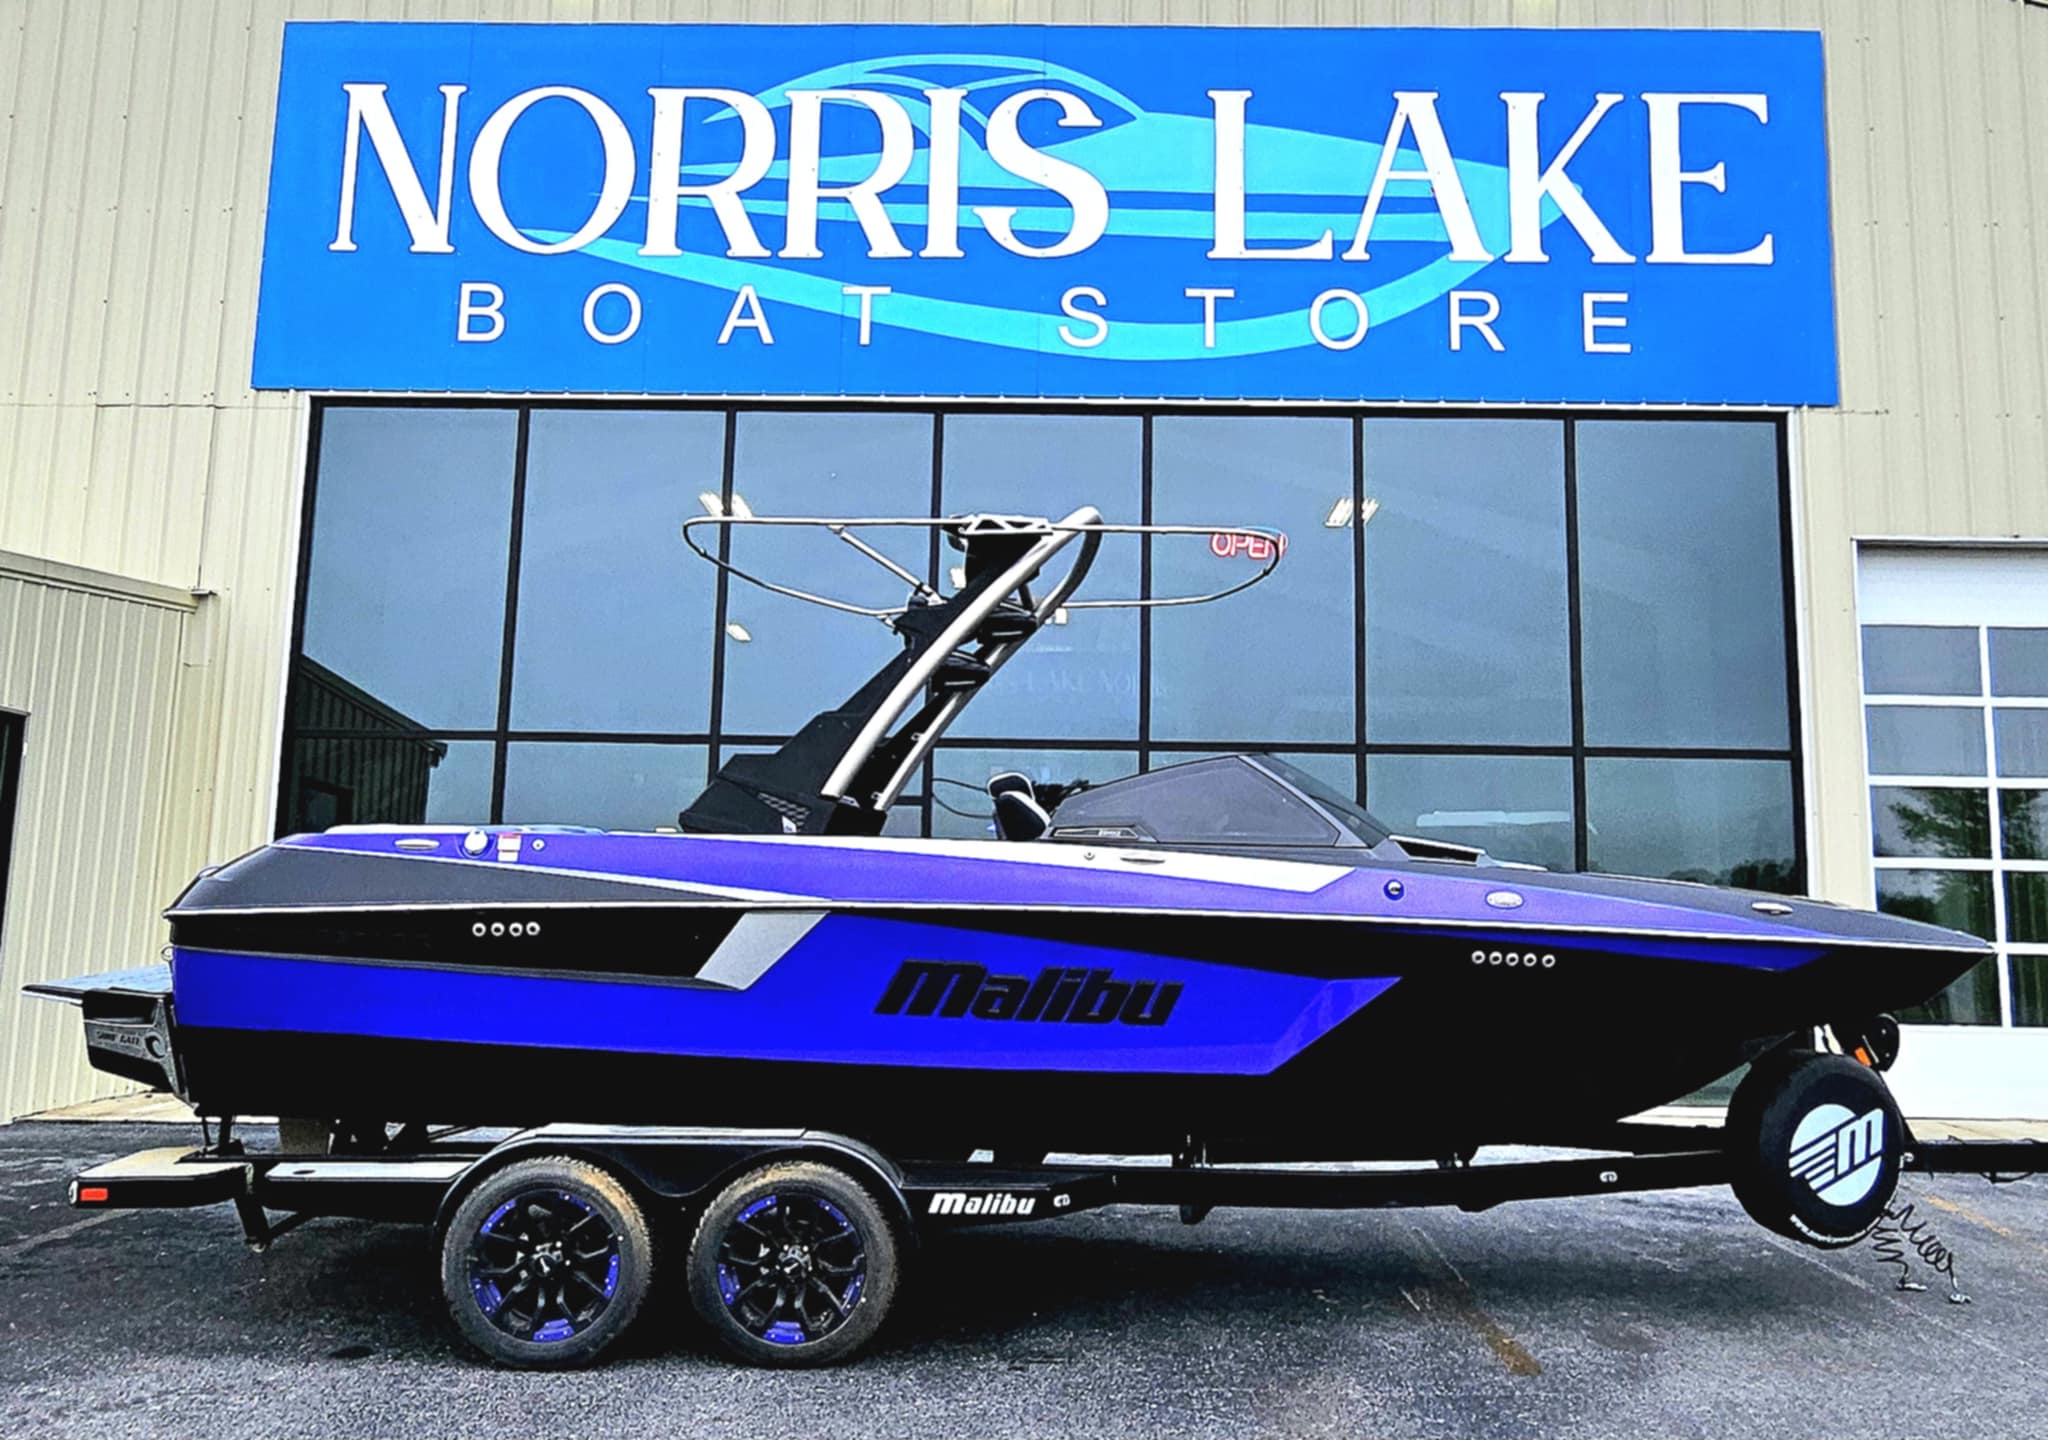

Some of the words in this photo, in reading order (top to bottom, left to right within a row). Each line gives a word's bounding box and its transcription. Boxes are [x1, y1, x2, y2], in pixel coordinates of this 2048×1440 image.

[328, 83, 1110, 259] NORRIS
[1206, 90, 1775, 266] LAKE
[456, 282, 892, 346] BOAT
[1057, 286, 1632, 354] STORE
[874, 959, 1184, 1026] Malibu
[928, 1193, 1036, 1214] Malibu
